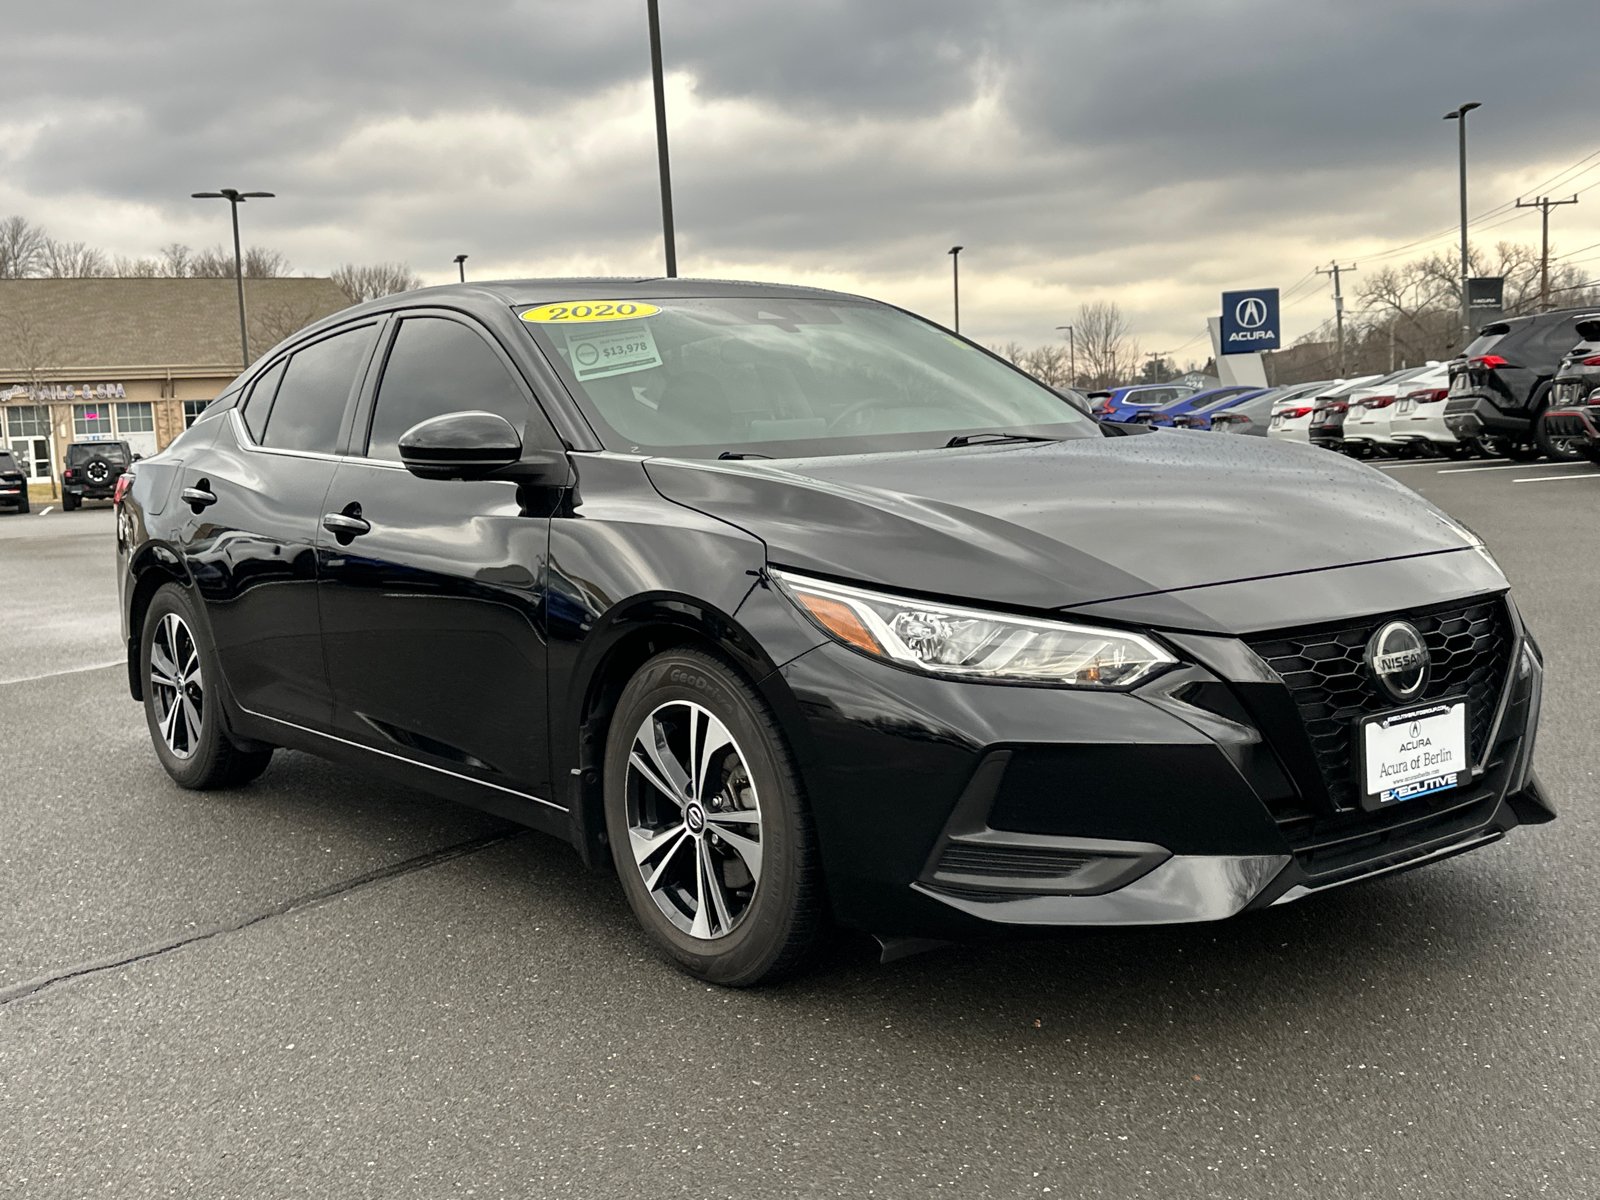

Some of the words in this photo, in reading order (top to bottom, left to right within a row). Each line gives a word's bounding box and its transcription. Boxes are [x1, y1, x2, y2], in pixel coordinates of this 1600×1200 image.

[548, 304, 637, 321] 2020
[1229, 330, 1275, 341] ACURA
[603, 342, 648, 358] $13,978
[82, 384, 93, 399] &
[97, 383, 126, 398] SPA
[1399, 737, 1432, 753] ACURA
[1380, 762, 1408, 778] Acura
[1410, 755, 1420, 770] of
[1423, 748, 1452, 767] Berlin
[1380, 773, 1458, 802] EXECUTIVE
